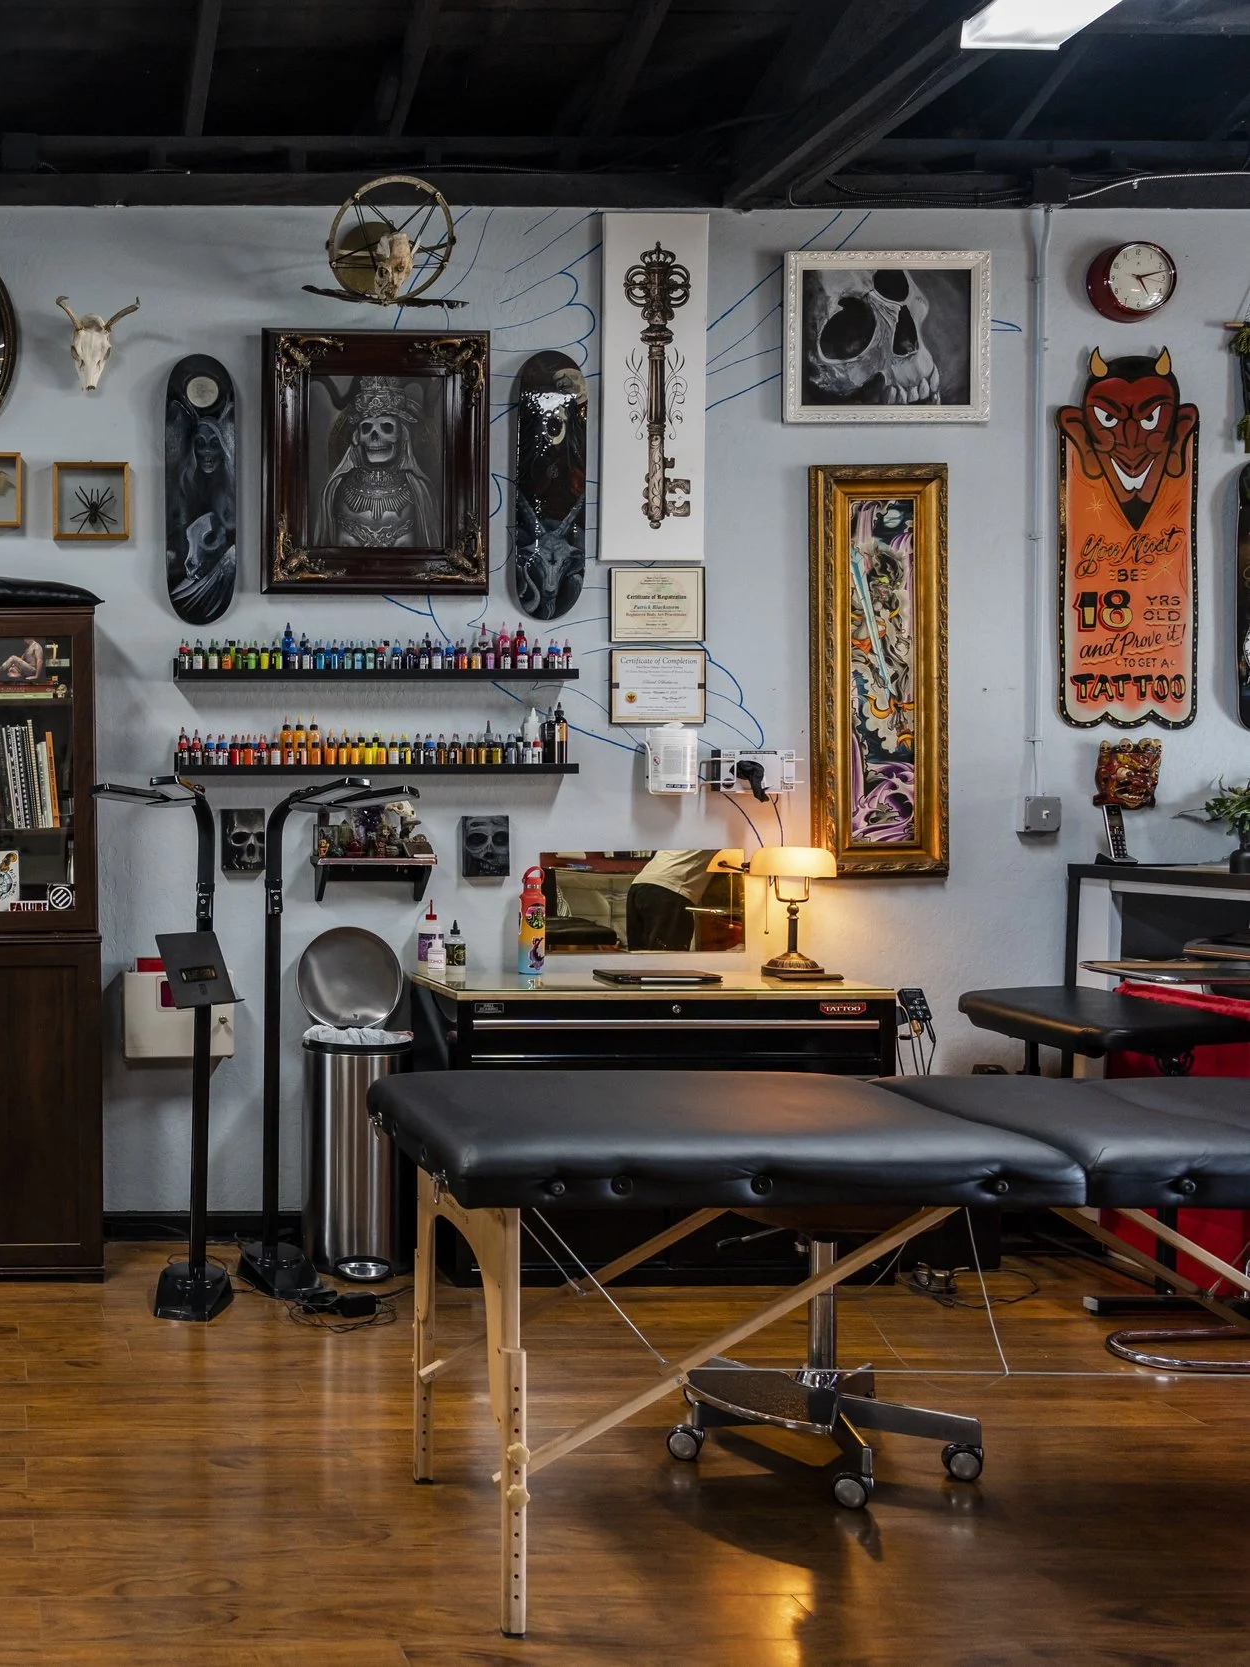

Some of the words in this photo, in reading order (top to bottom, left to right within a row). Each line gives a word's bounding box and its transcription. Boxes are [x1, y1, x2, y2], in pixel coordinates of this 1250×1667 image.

[1076, 535, 1120, 576] You
[1114, 526, 1184, 564] Must
[1117, 568, 1140, 582] BE
[1146, 595, 1181, 606] YRS
[1073, 589, 1134, 632] 18
[1143, 610, 1181, 622] OLD
[1079, 633, 1121, 659] and
[1120, 631, 1162, 656] Prove
[1166, 624, 1187, 645] it!
[620, 657, 652, 665] Certificate
[654, 657, 661, 665] of
[662, 657, 698, 665] Completion
[1122, 658, 1136, 668] TO
[1138, 657, 1156, 668] GET
[1160, 658, 1169, 668] A
[1071, 673, 1187, 703] TATTOO
[9, 902, 48, 911] FAILURE
